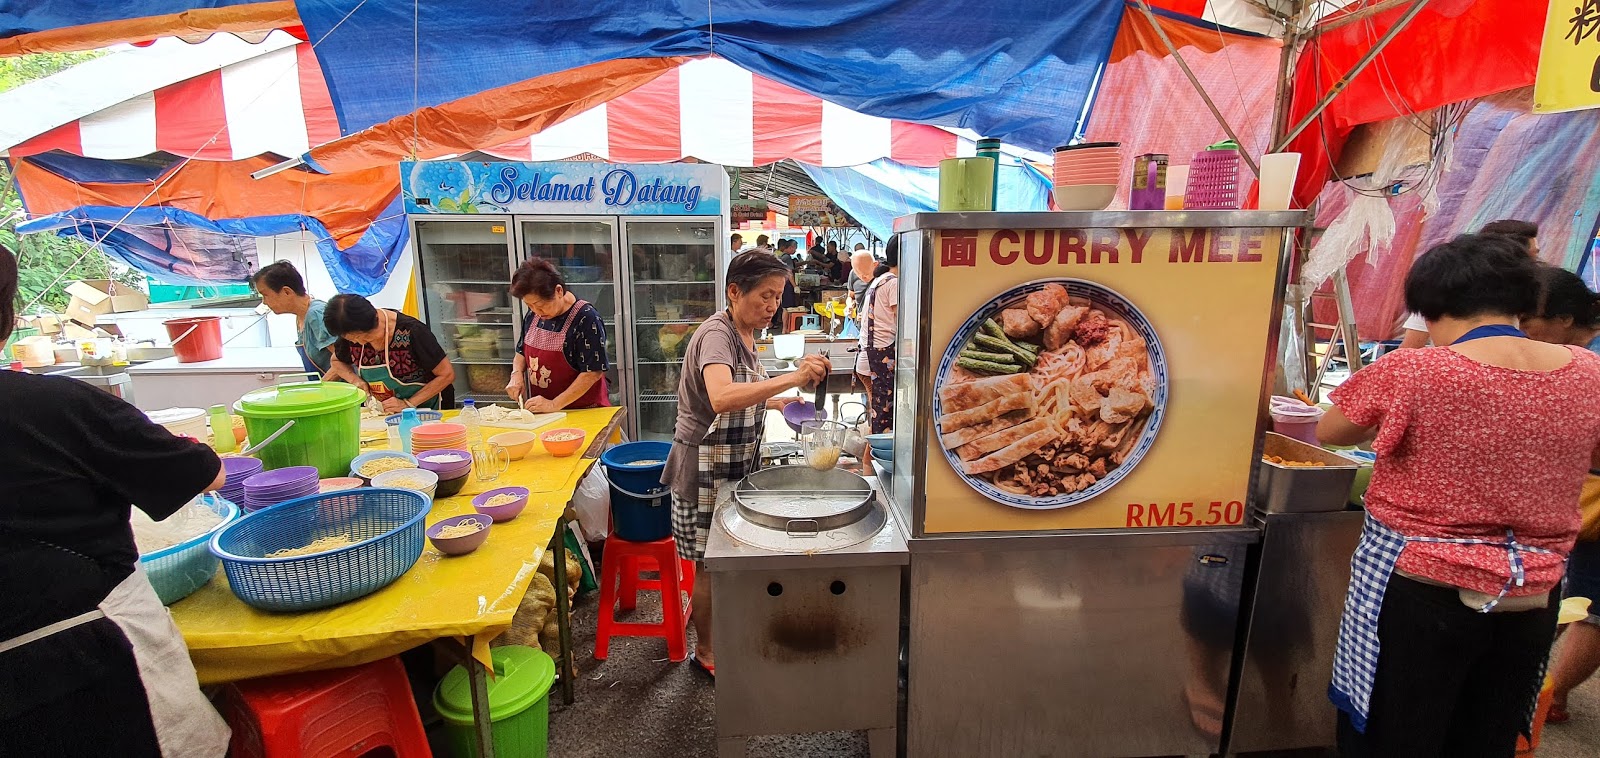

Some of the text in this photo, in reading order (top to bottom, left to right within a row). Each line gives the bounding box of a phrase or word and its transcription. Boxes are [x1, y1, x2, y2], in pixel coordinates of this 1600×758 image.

[491, 166, 702, 212] Selamat Datang
[989, 228, 1153, 266] CURRY
[1168, 227, 1265, 264] MEE
[1126, 500, 1244, 527] RM5.50
